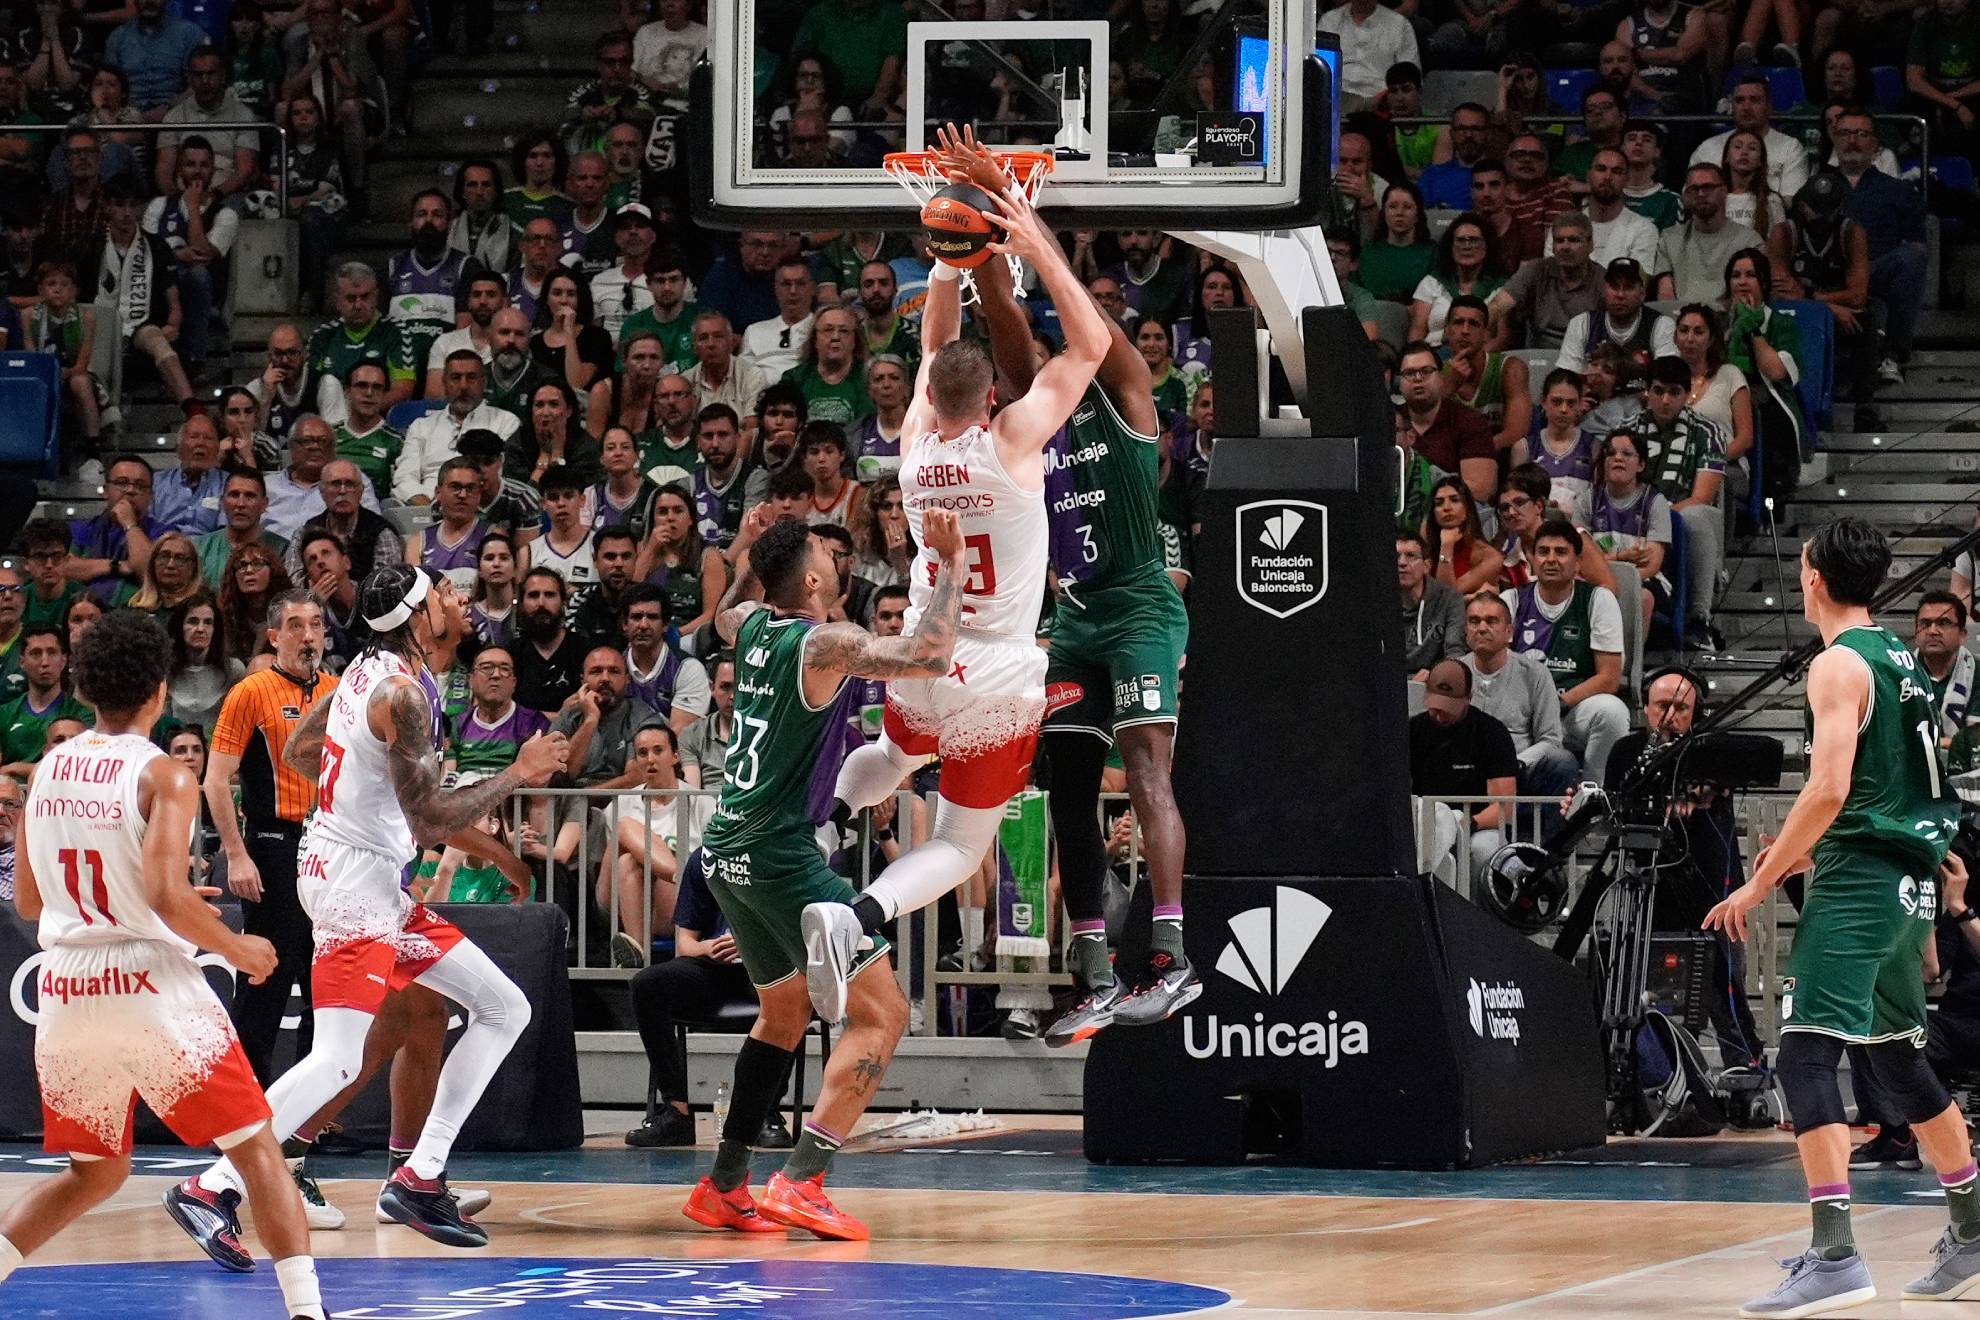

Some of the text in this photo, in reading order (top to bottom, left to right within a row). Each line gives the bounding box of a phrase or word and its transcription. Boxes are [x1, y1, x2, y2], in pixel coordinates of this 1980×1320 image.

[1205, 133, 1249, 143] PLAYOFF
[917, 464, 970, 488] GEBEN
[1075, 524, 1099, 564] 3
[1251, 555, 1313, 568] Fundación
[1260, 569, 1305, 584] Unicaja
[1251, 582, 1314, 593] Baloncesto
[724, 710, 768, 790] 23
[52, 754, 124, 784] TAYLOR
[35, 794, 122, 819] inmoovs
[730, 862, 751, 875] SOL
[58, 848, 118, 927] 11
[41, 967, 160, 1005] Aquaflix
[1480, 980, 1525, 1010] Fundación
[1183, 1010, 1369, 1069] Unicaja
[1486, 1010, 1521, 1047] Unicaja
